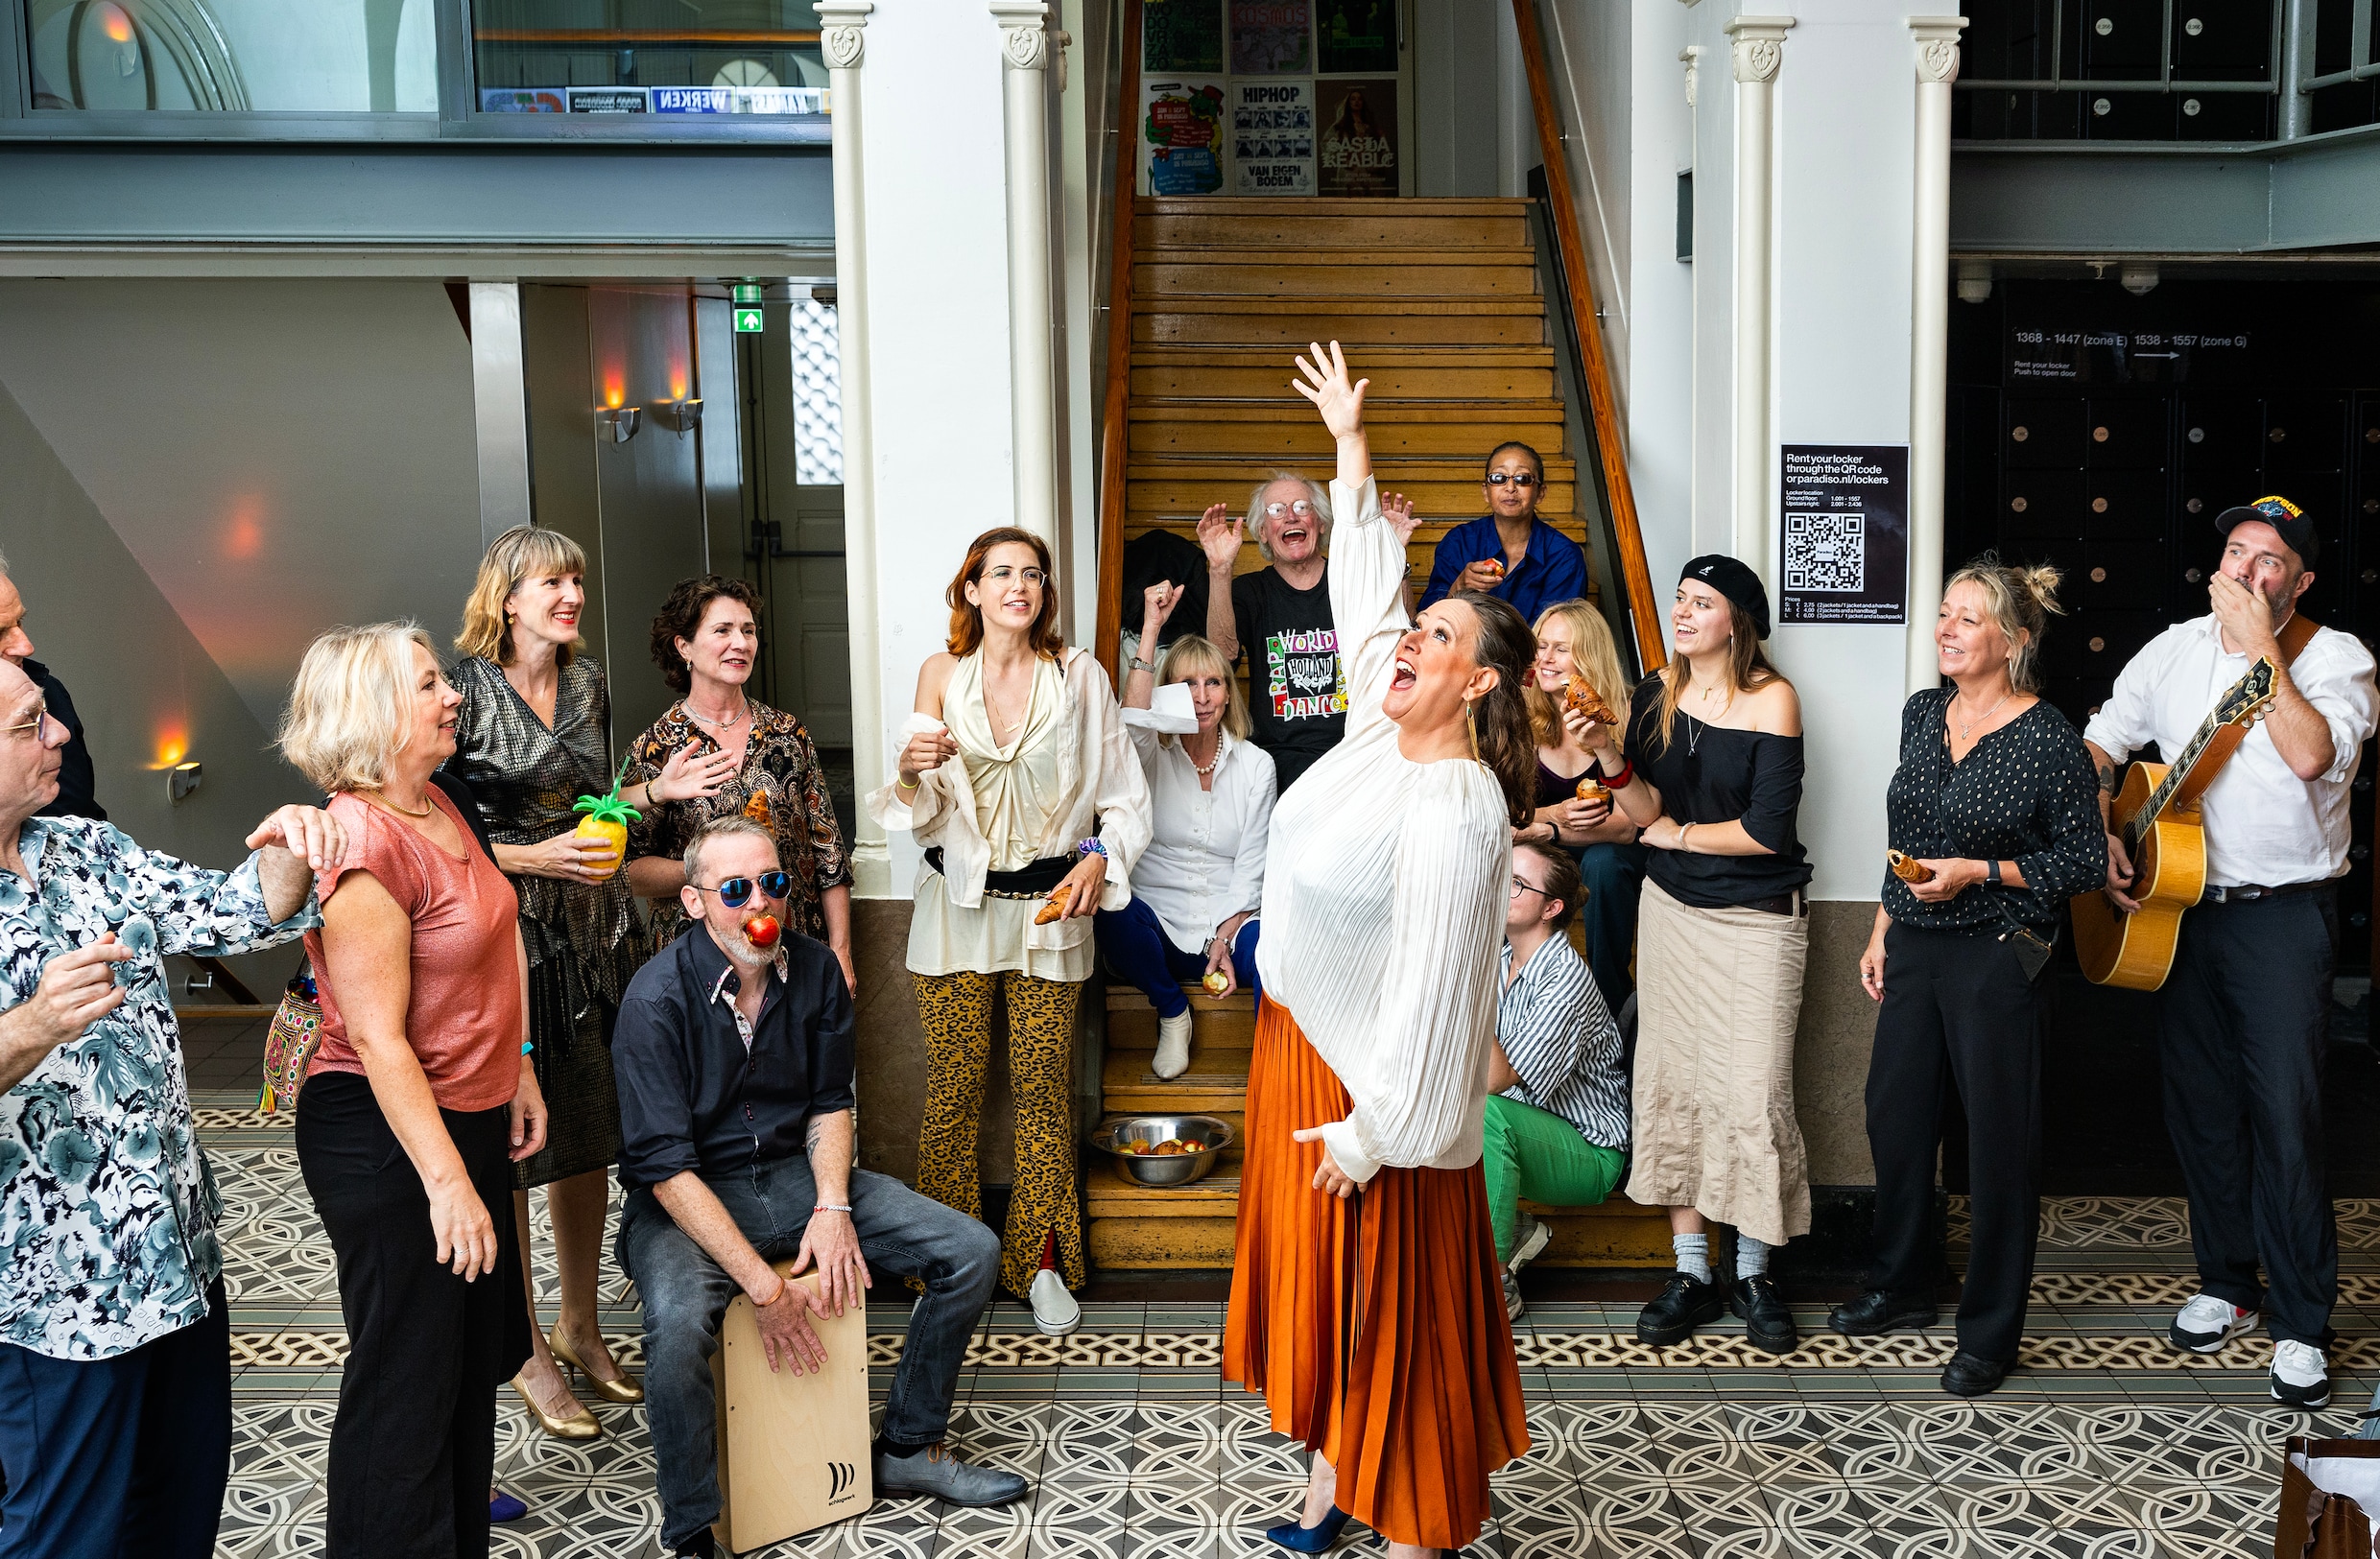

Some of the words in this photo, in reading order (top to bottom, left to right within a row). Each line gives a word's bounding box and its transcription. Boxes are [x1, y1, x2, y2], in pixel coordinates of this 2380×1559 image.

[1232, 5, 1307, 25] KOSMOS
[1243, 86, 1299, 103] HIPHOP
[1249, 166, 1269, 176] VAN
[1273, 165, 1300, 176] EIGEN
[1257, 177, 1294, 186] BODEM
[2016, 333, 2042, 343] 1368
[2056, 334, 2081, 344] 1447
[2083, 334, 2114, 347] (zone
[2116, 336, 2128, 347] E)
[2134, 336, 2160, 345] 1538
[2173, 336, 2198, 346] 1557
[2201, 336, 2232, 347] (zone
[2234, 336, 2248, 348] G)
[2032, 362, 2048, 370] your
[2049, 361, 2070, 369] locker
[1787, 454, 1810, 462] Rent
[1810, 456, 1833, 464] your
[1833, 455, 1864, 463] locker
[1786, 464, 1823, 475] through
[1824, 464, 1840, 474] the
[1841, 464, 1856, 474] QR
[1857, 465, 1882, 474] code
[1797, 474, 1889, 484] paradiso.nl/lockers
[1277, 627, 1334, 652] WORLD
[1267, 652, 1288, 697] RAP
[1282, 696, 1342, 721] DANCE
